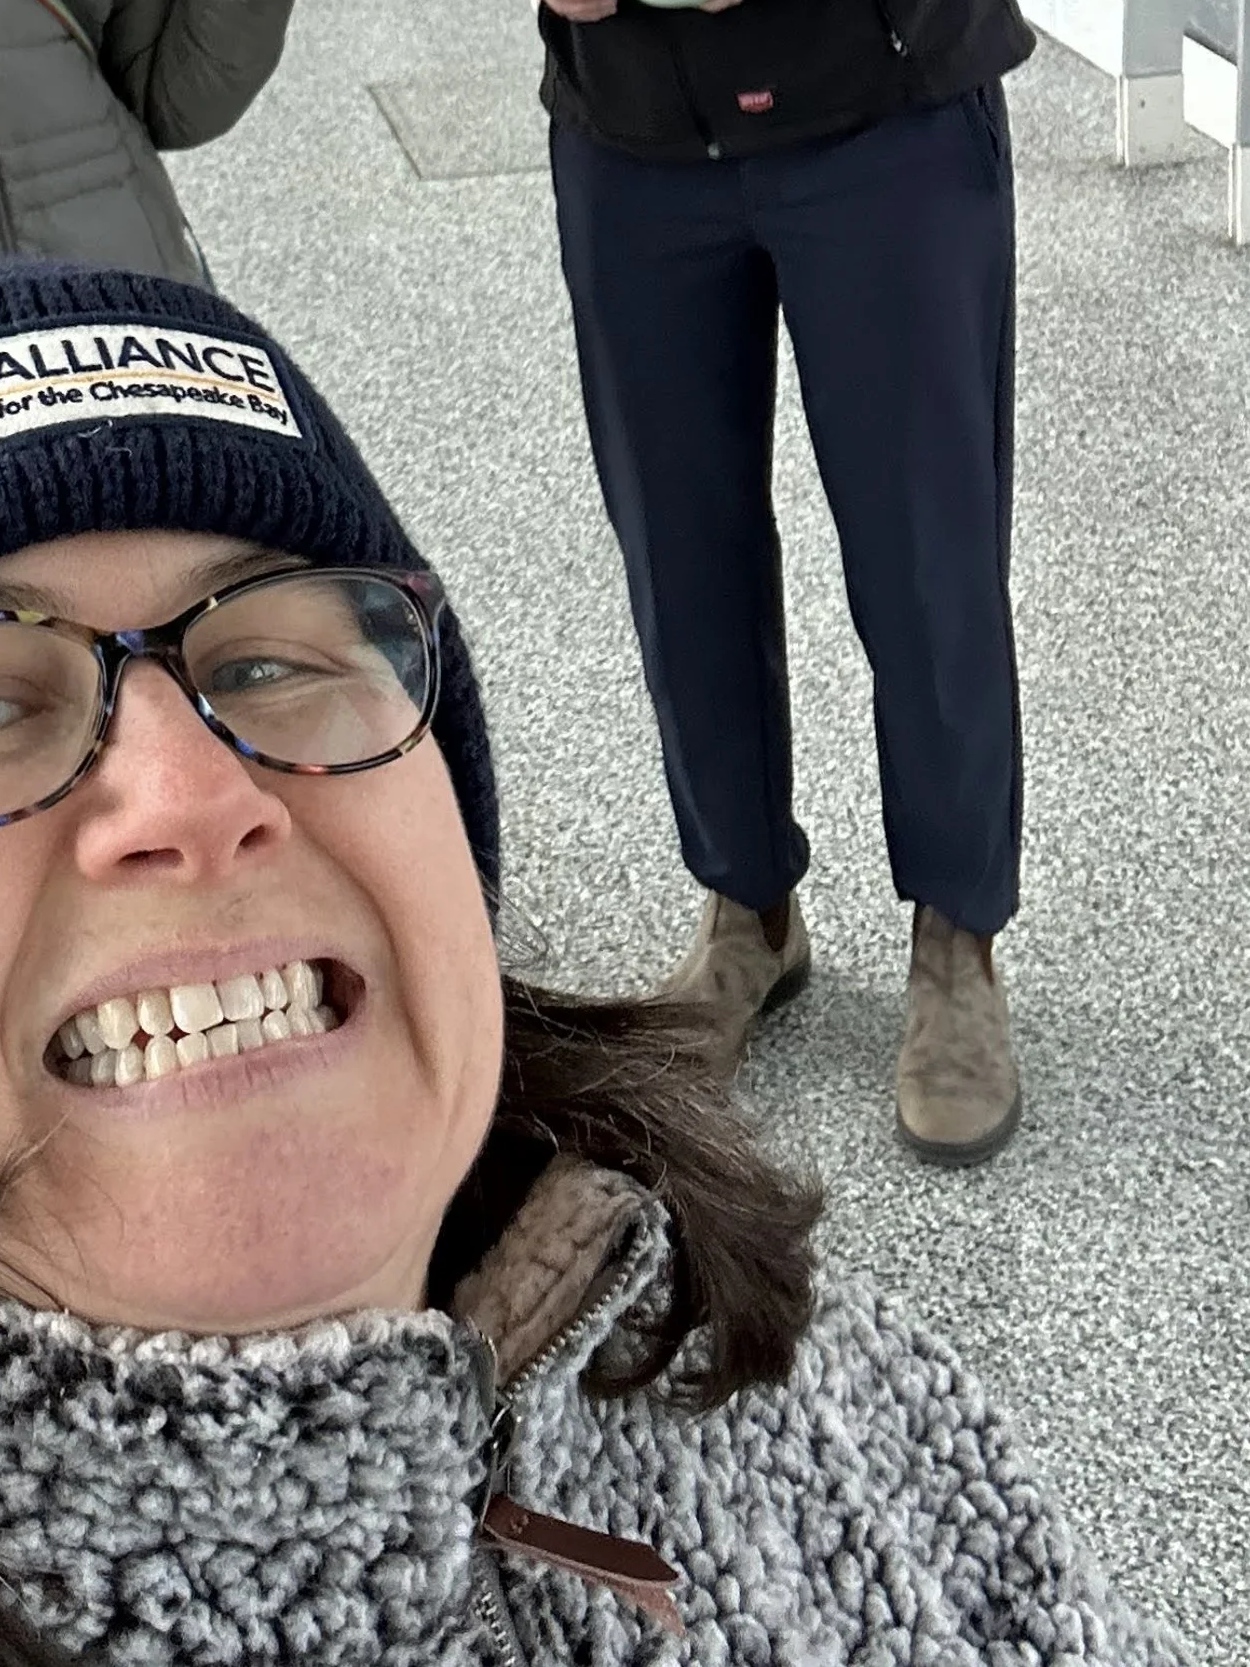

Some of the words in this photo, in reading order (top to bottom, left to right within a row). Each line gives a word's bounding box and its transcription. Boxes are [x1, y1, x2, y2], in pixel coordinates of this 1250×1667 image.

[37, 386, 84, 408] the
[89, 381, 246, 409] Chesapeake
[249, 393, 289, 426] Bay
